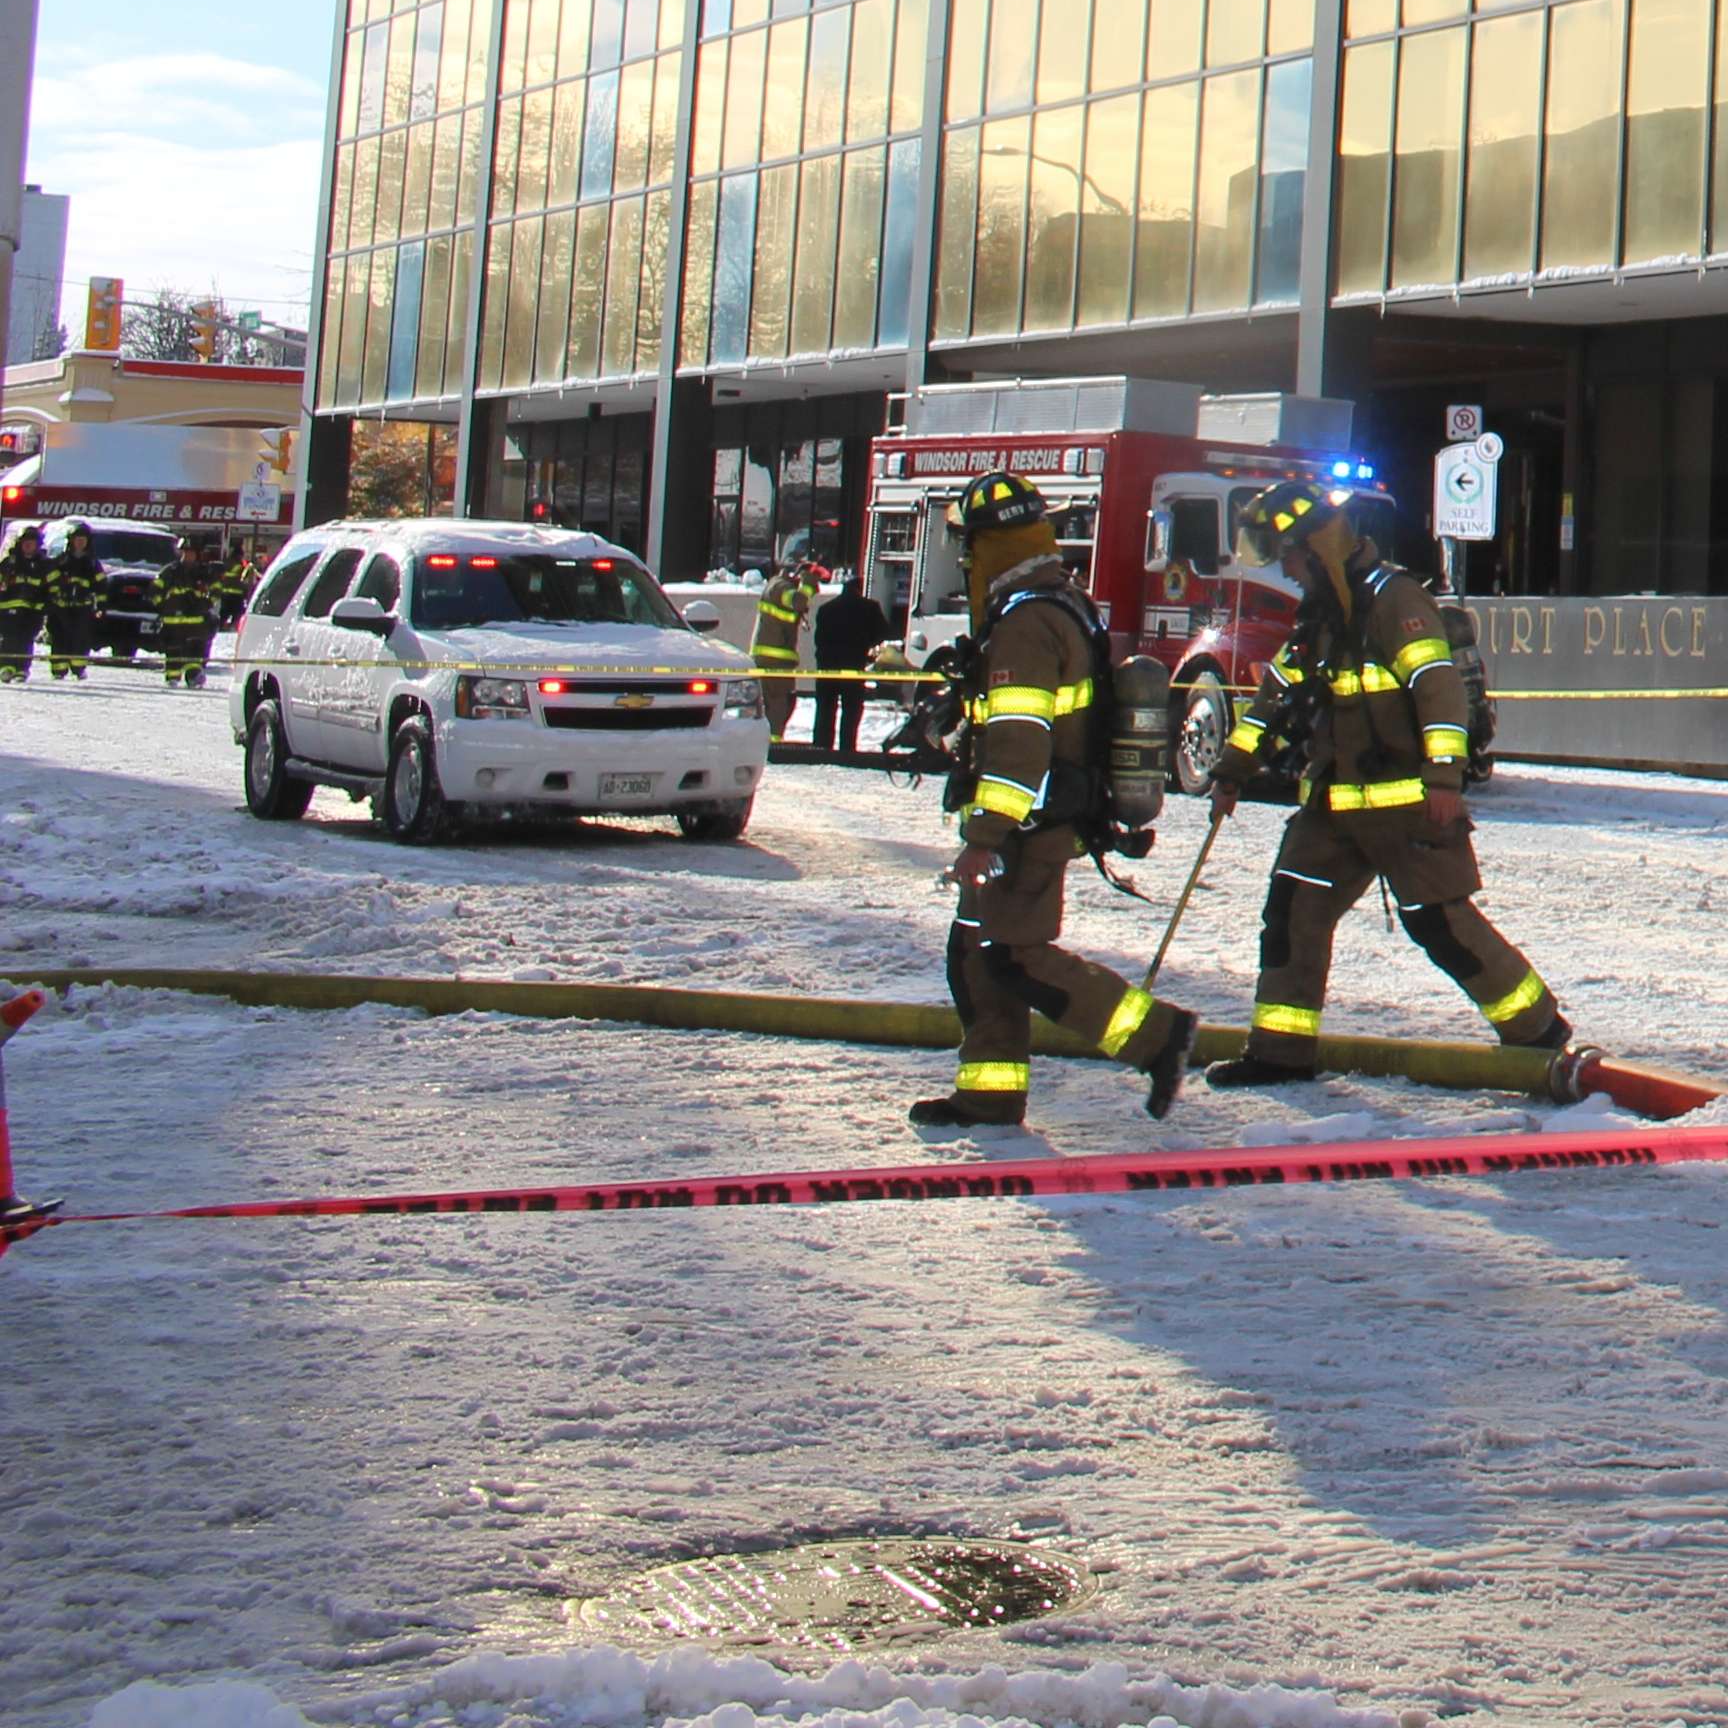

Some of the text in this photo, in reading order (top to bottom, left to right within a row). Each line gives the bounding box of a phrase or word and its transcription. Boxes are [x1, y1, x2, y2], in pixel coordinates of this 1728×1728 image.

[915, 452, 966, 472] WINDSOR
[968, 451, 996, 471] FIRE
[1010, 448, 1060, 471] RESCUE
[36, 501, 239, 521] WINDSOR FIRE & RES
[1449, 508, 1476, 518] SELF
[1440, 519, 1490, 532] PARKING
[1583, 606, 1707, 657] PLACE
